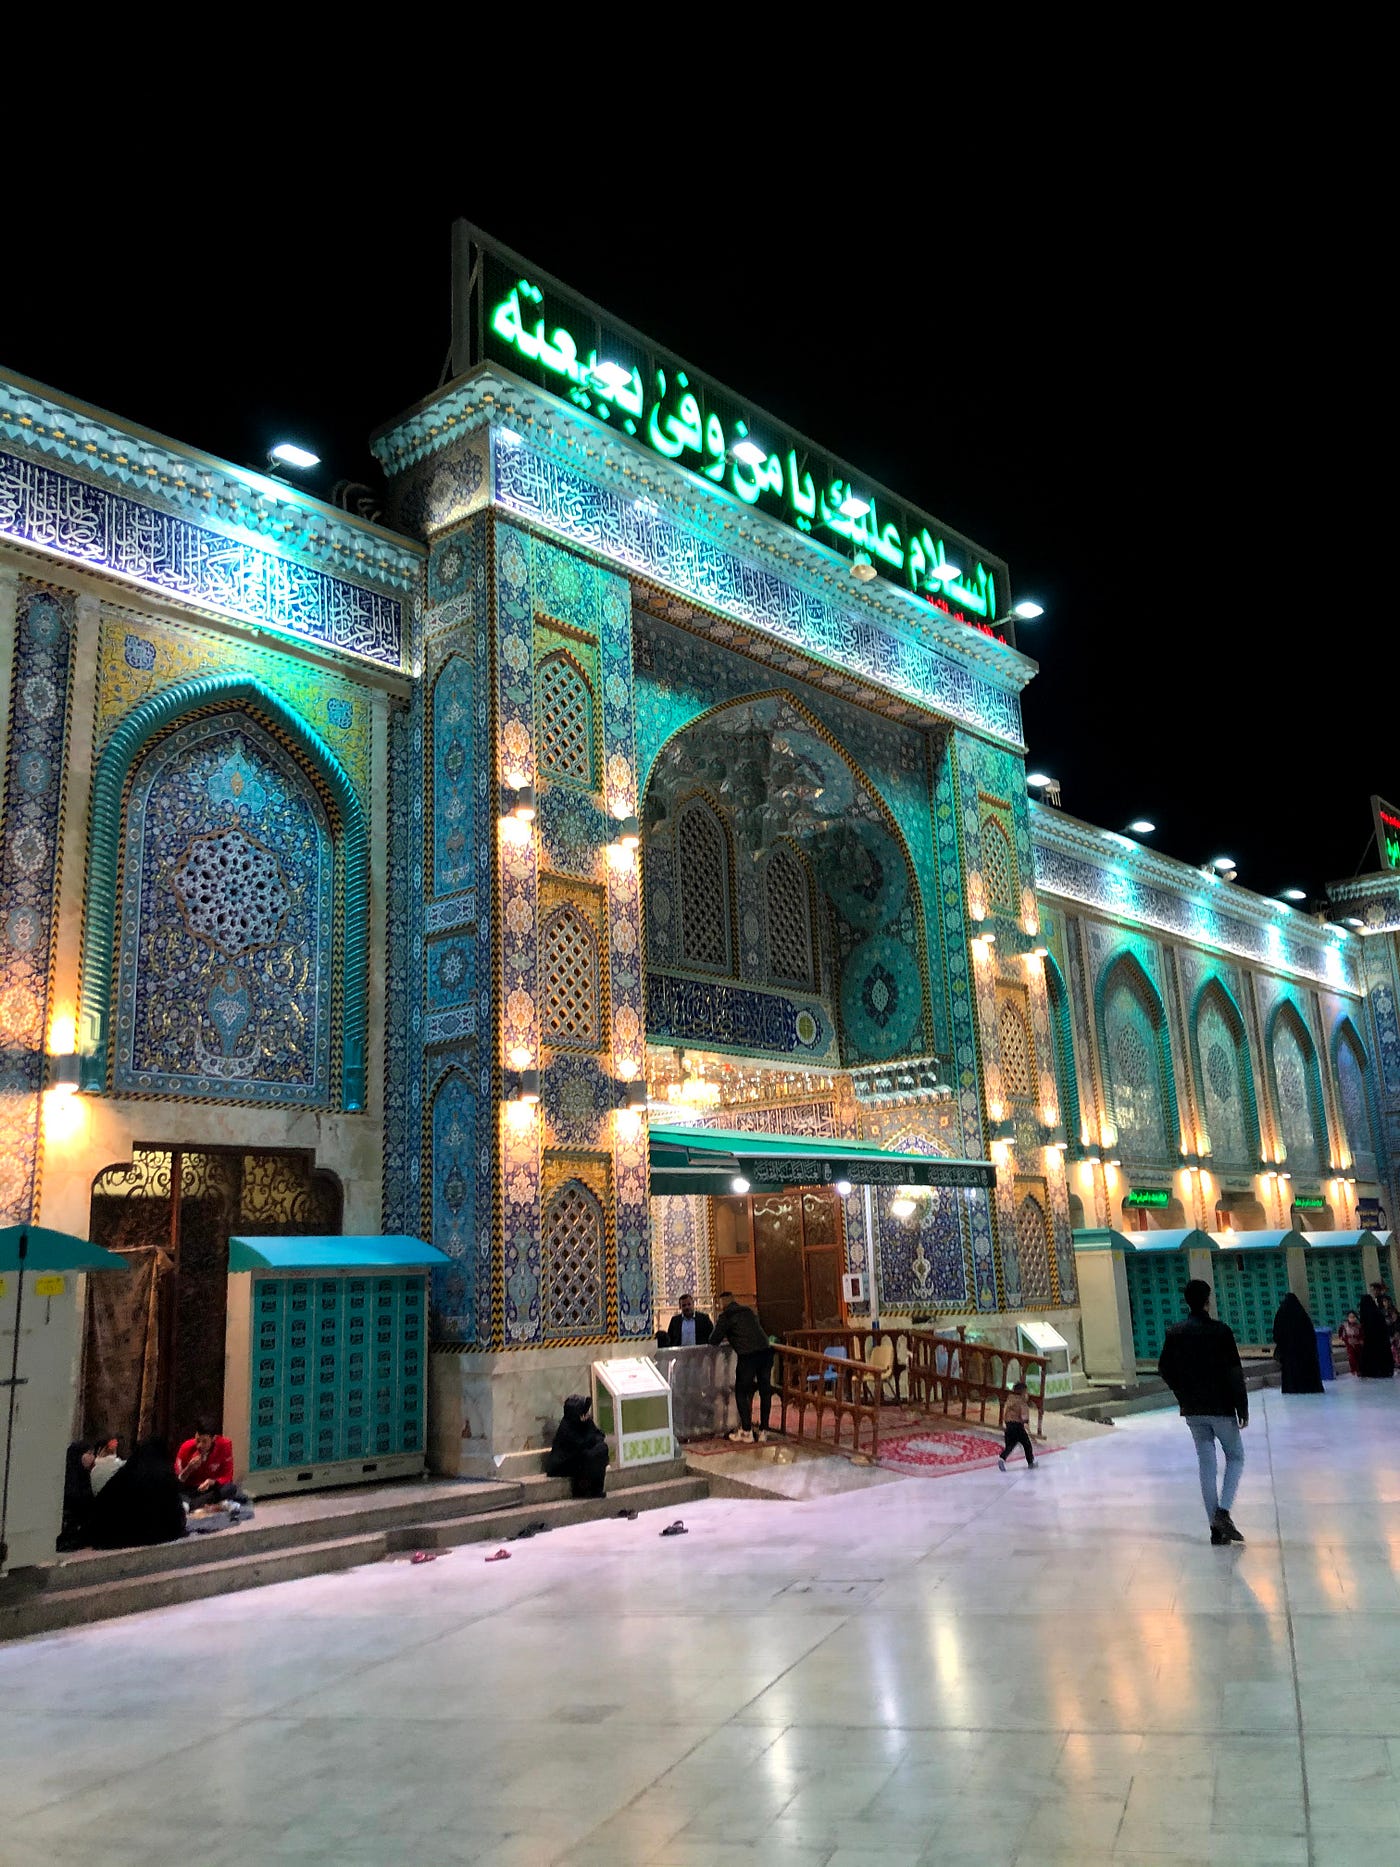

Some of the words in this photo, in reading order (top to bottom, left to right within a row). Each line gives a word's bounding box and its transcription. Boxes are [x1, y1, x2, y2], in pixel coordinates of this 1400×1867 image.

[732, 420, 784, 505] من
[788, 449, 816, 532] يا
[907, 528, 996, 621] السلام
